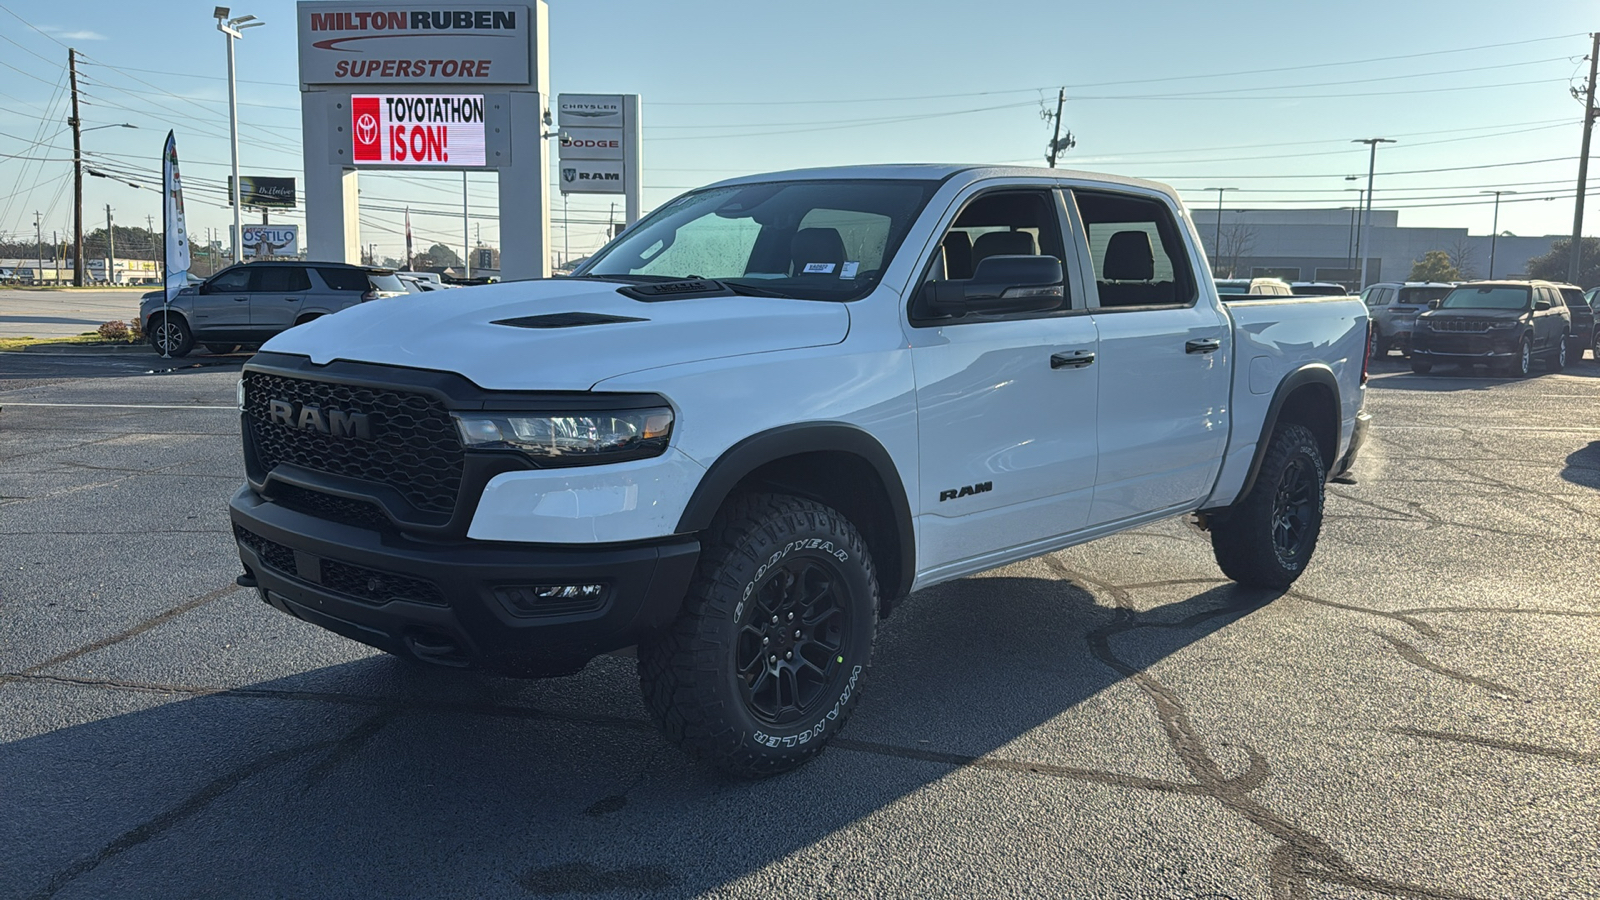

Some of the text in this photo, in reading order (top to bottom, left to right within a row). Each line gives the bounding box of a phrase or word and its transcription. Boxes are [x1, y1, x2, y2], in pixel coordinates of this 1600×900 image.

[311, 11, 516, 31] MILTON RUBEN
[334, 59, 492, 78] SUPERSTORE
[386, 97, 484, 123] TOYOTATHON
[390, 125, 449, 162] IS ON!
[562, 140, 620, 148] DODGE
[579, 173, 620, 181] RAM
[243, 231, 294, 241] OSTILO
[269, 399, 371, 440] RAM
[939, 481, 992, 502] RAM
[733, 539, 848, 623] GOODYEAR
[753, 665, 862, 748] WRANGLER
